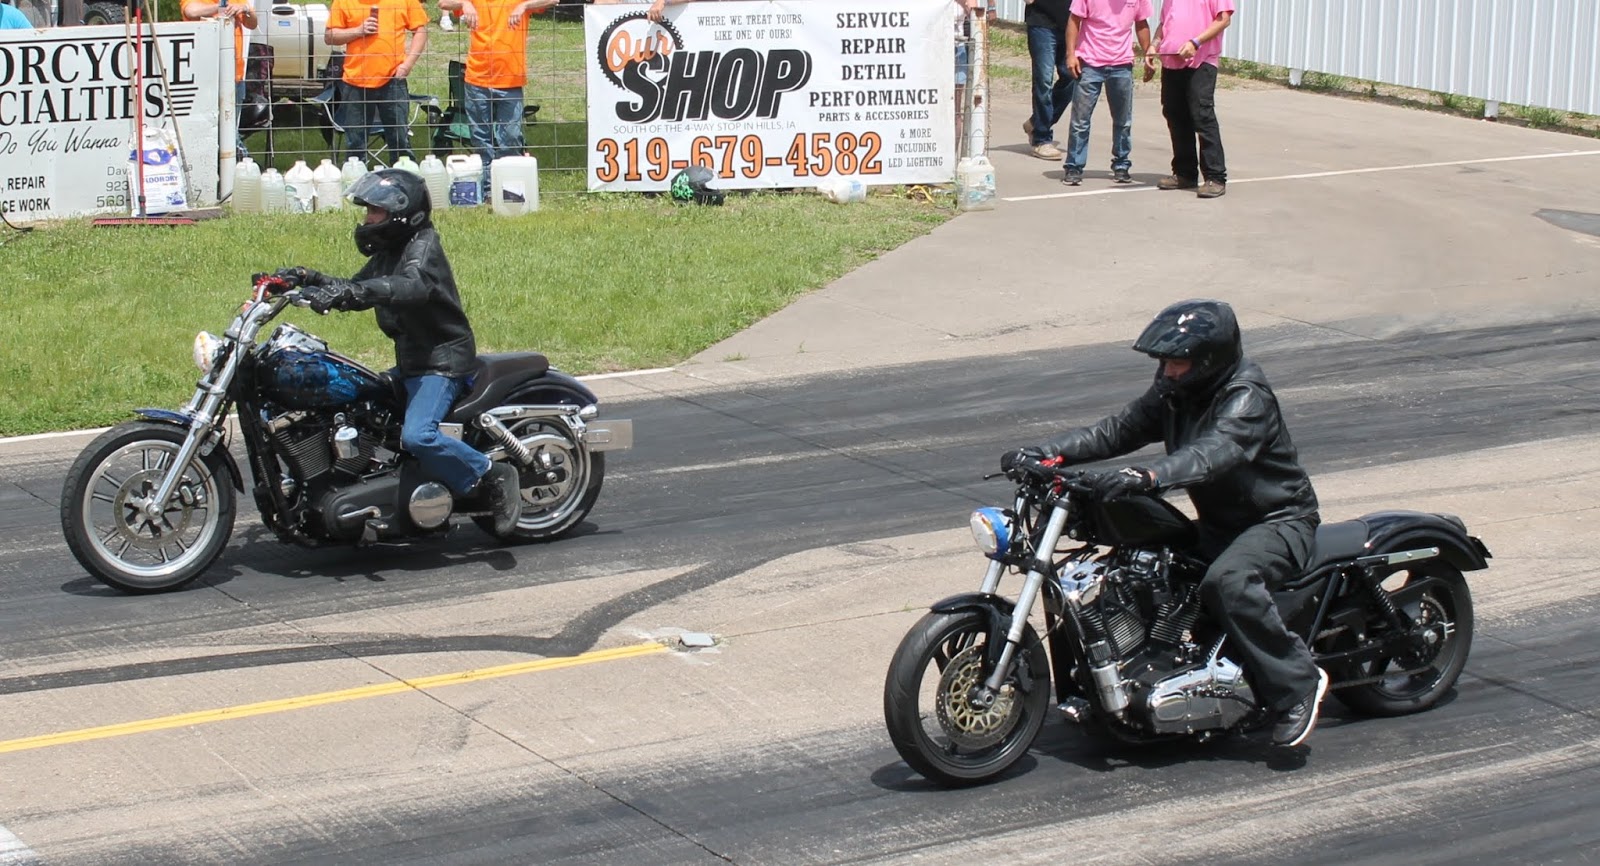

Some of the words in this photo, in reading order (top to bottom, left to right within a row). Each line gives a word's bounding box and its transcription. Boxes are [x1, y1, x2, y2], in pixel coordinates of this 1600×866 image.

[697, 15, 728, 26] WHERE
[730, 15, 743, 25] WE
[746, 14, 772, 25] TREAT
[774, 14, 805, 26] YOURS,
[837, 12, 910, 28] SERVICE
[714, 30, 733, 40] LIKE
[736, 30, 752, 40] ONE
[756, 29, 766, 39] OF
[769, 28, 793, 39] OURS!
[607, 30, 675, 72] Our
[841, 38, 906, 54] REPAIR
[842, 64, 906, 80] DETAIL
[615, 48, 812, 124] SHOP
[809, 89, 938, 107] PERFORMANCE
[819, 112, 850, 122] PARTS
[854, 111, 861, 121] &
[865, 110, 929, 121] ACCESSORIES
[613, 125, 647, 135] SOUTH
[648, 125, 662, 133] OF
[665, 124, 682, 133] THE
[684, 123, 714, 132] 4-WAY
[717, 122, 742, 131] STOP
[743, 121, 753, 130] IN
[756, 120, 784, 131] HILLS,
[786, 120, 796, 129] IA
[900, 129, 905, 138] &
[909, 128, 932, 139] MORE
[27, 128, 58, 155] You
[64, 126, 121, 153] Wanna
[894, 143, 937, 154] INCLUDING
[596, 131, 882, 182] 319-679-4582
[888, 157, 903, 168] LED
[907, 156, 943, 167] LIGHTING
[8, 176, 46, 190] REPAIR
[18, 198, 51, 212] WORK
